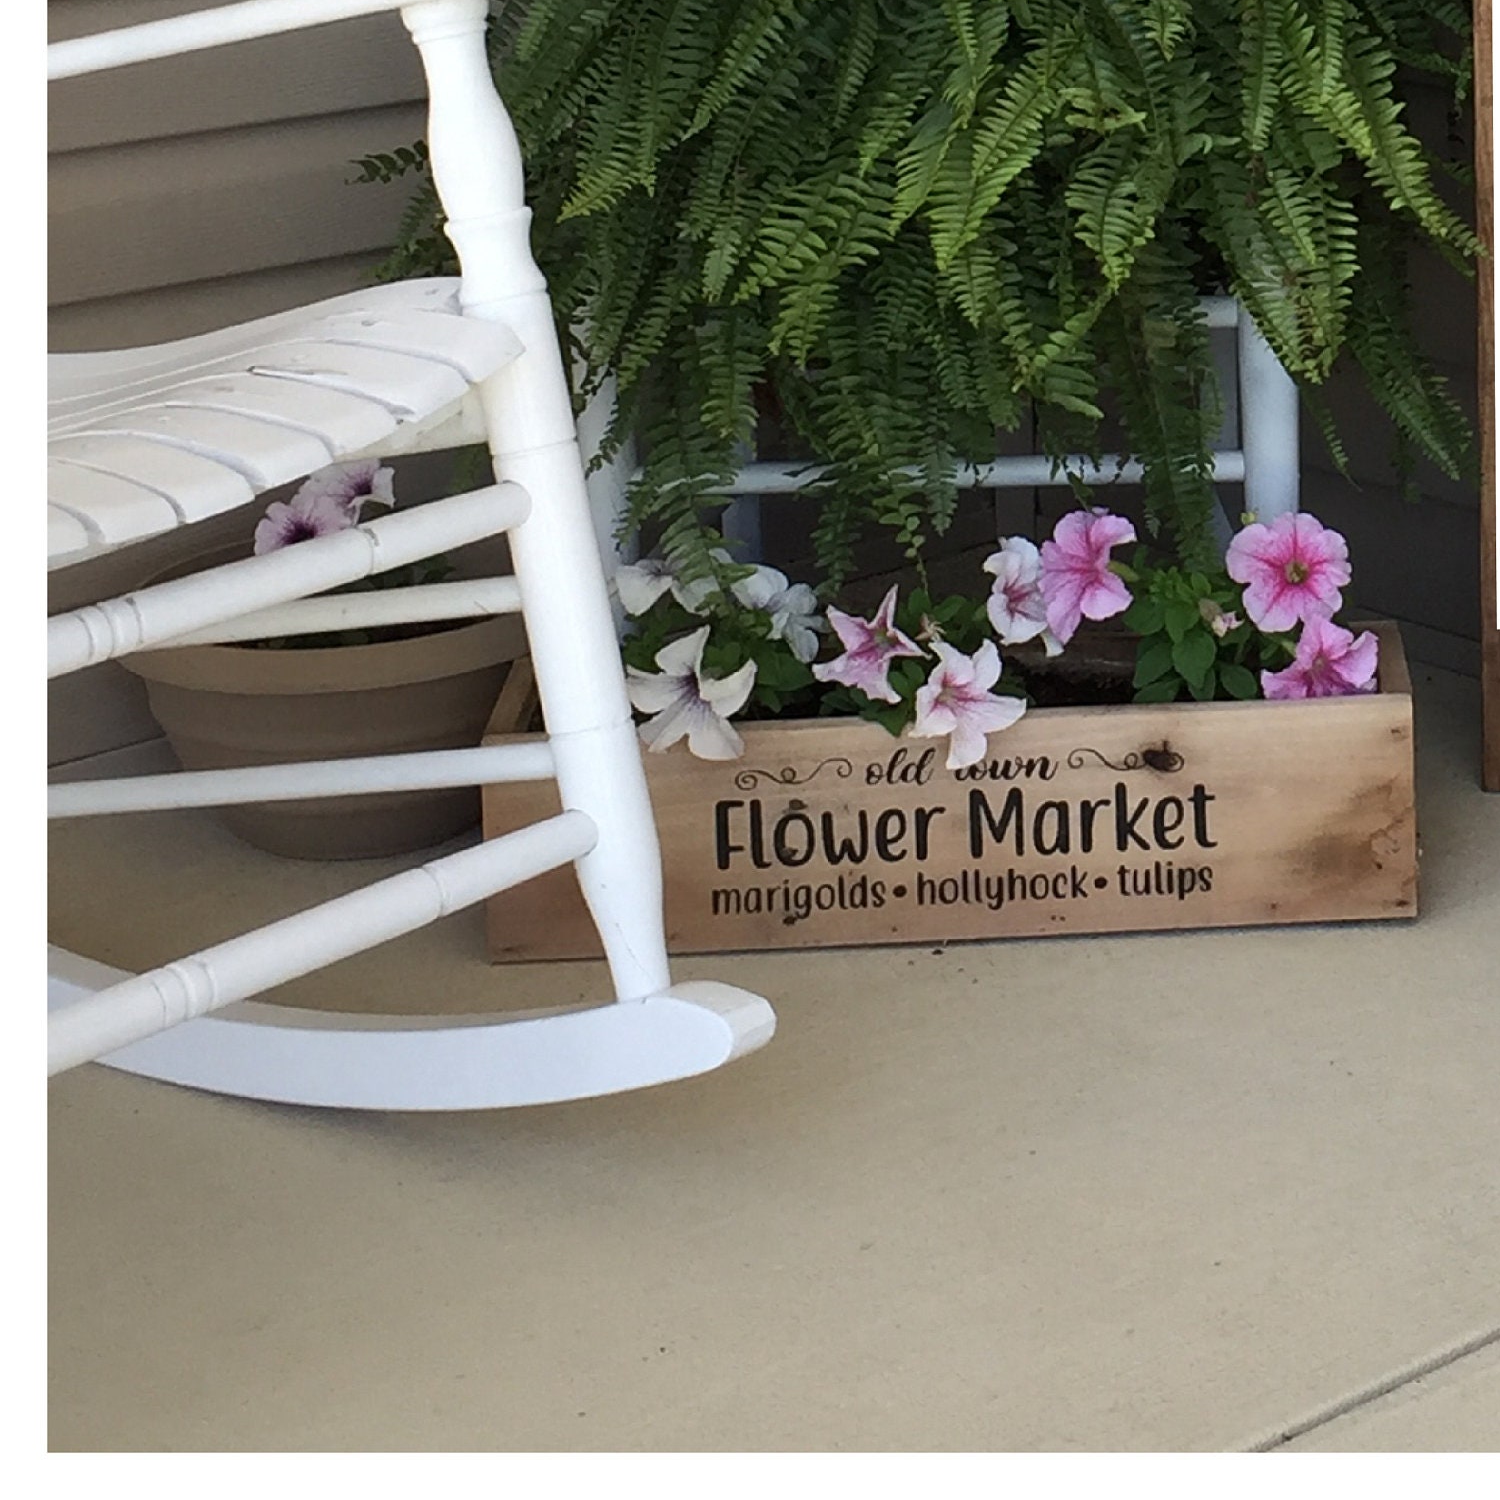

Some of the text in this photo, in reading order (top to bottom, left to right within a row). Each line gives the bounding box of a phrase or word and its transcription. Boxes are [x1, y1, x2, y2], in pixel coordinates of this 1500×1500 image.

[864, 746, 937, 786] old
[714, 782, 1218, 870] Flower Market
[711, 860, 1213, 920] marigolds hollyhock tulips
